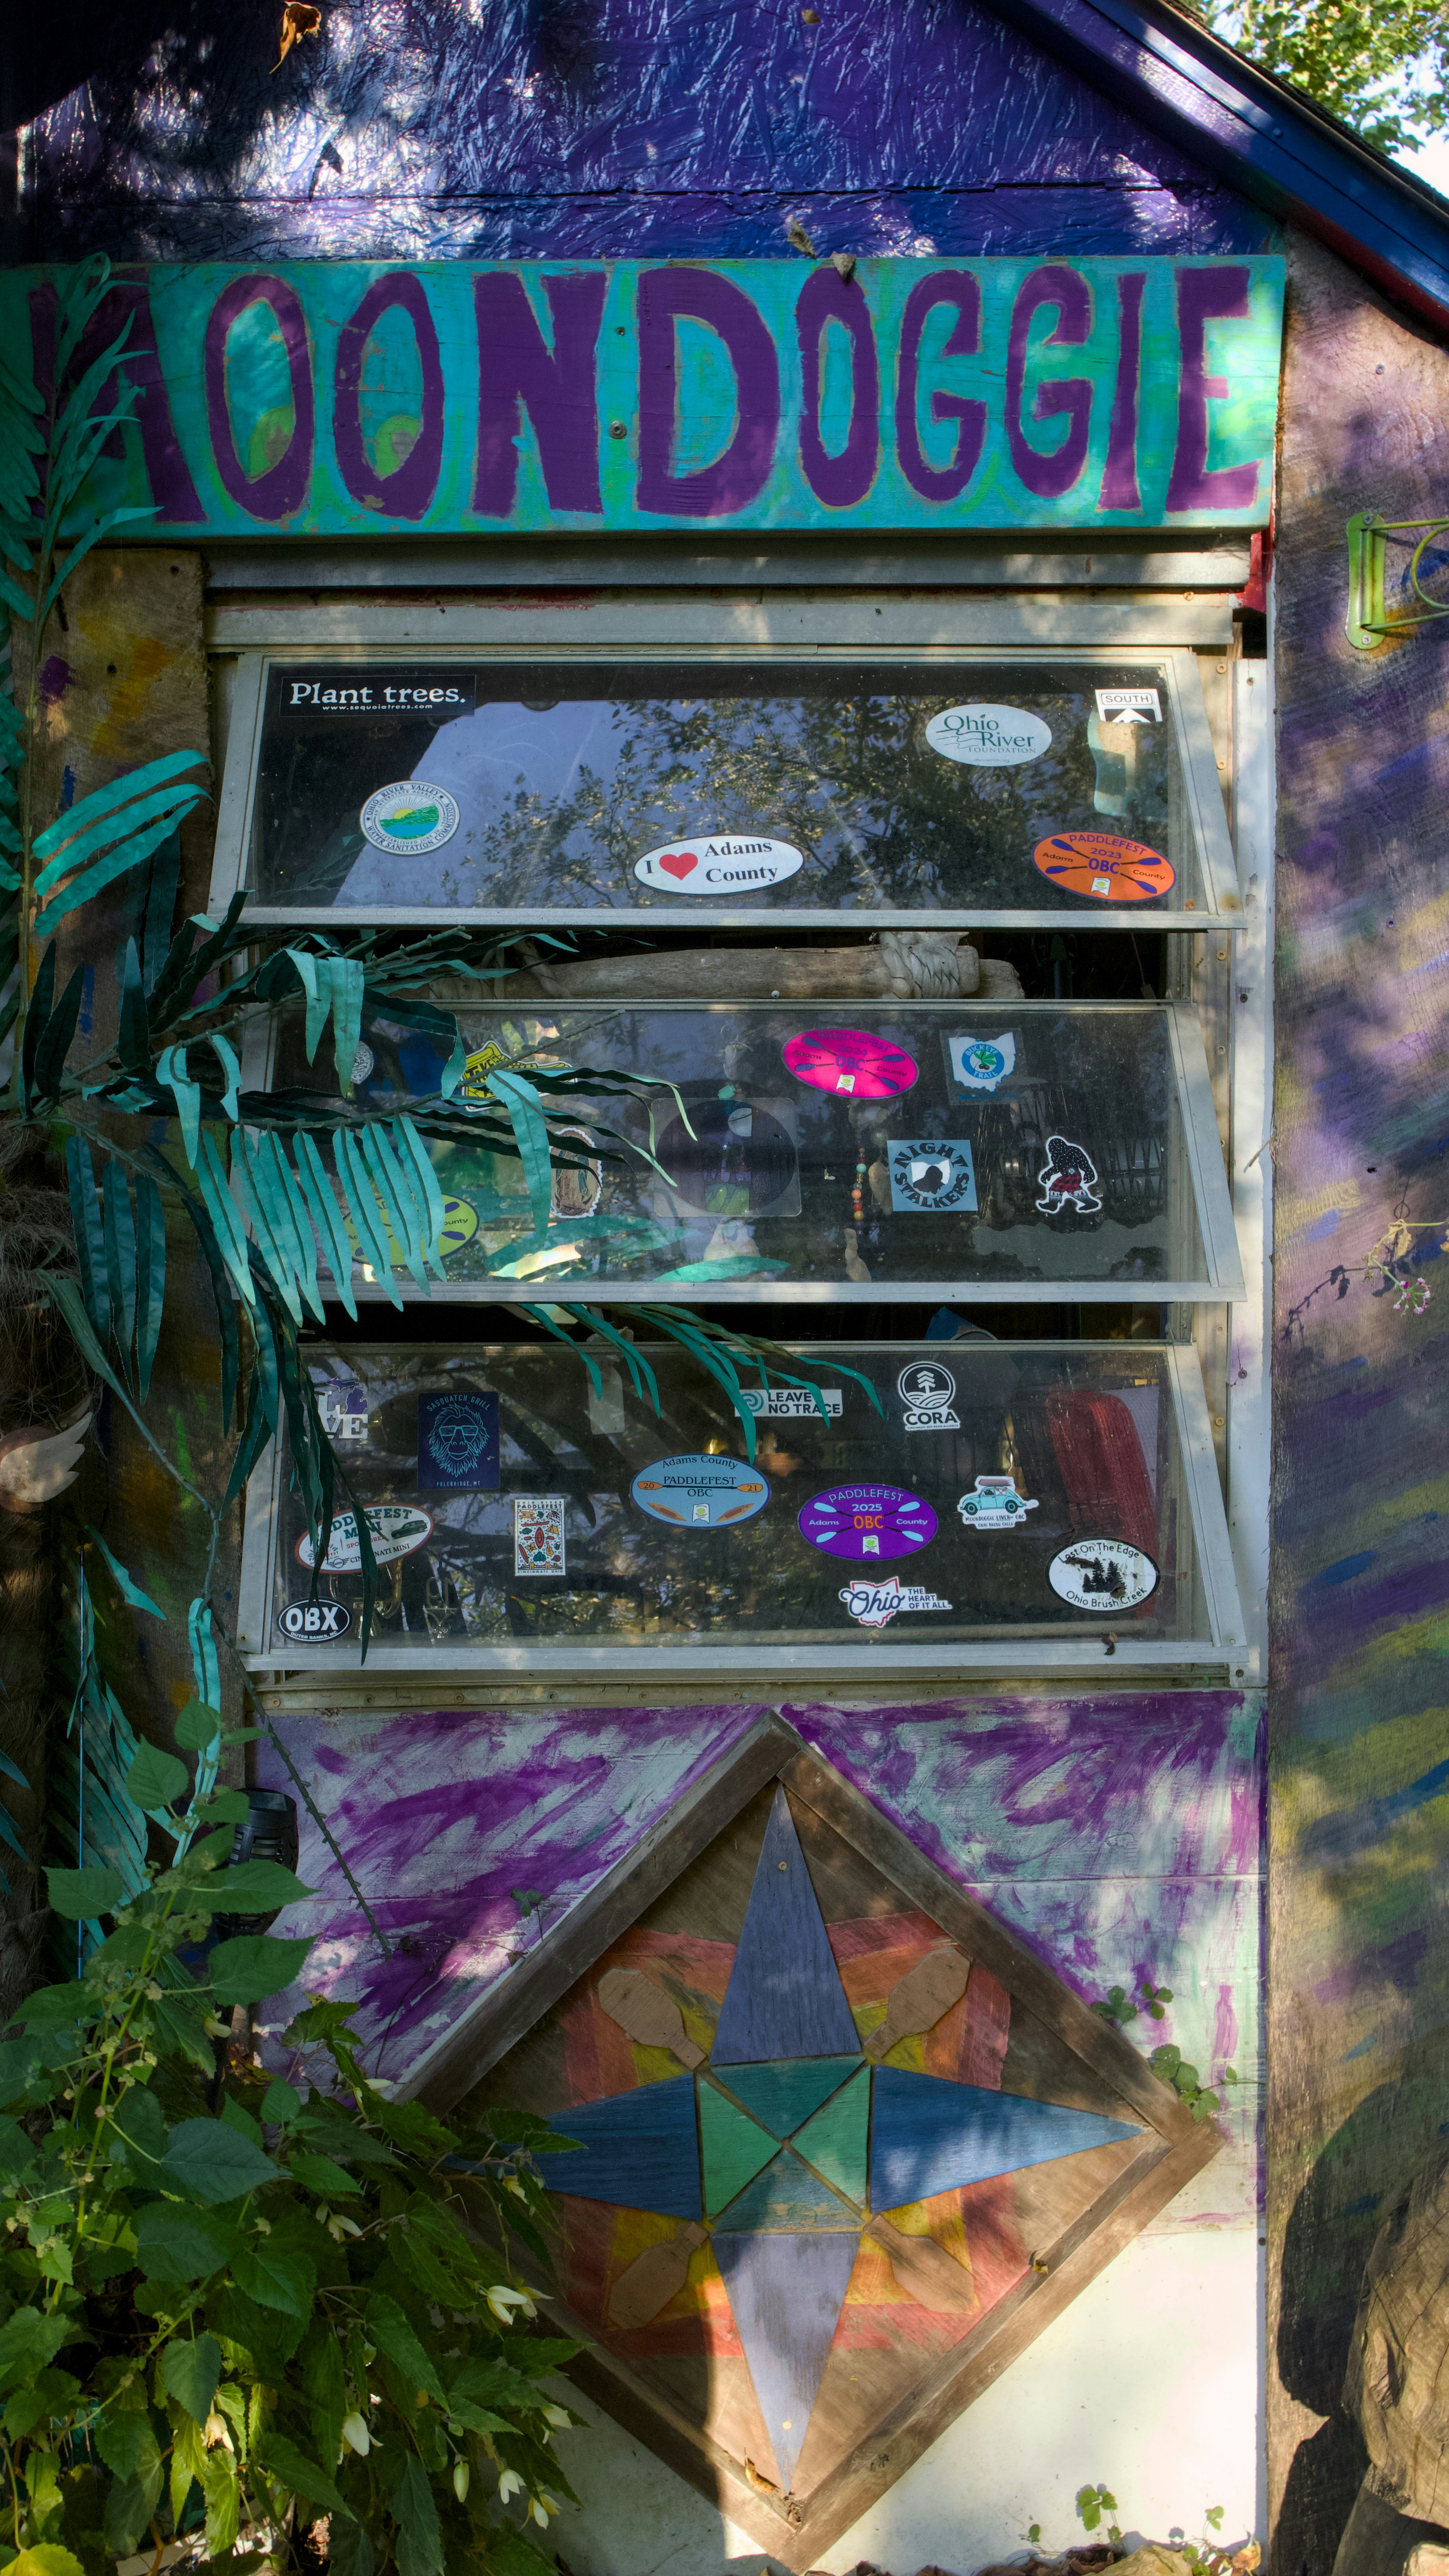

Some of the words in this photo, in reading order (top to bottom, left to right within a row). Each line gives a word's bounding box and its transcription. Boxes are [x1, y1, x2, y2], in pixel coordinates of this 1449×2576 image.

[290, 683, 373, 704] Plant
[383, 686, 466, 703] trees.
[944, 714, 999, 730] Ohio
[981, 732, 1034, 747] River
[367, 799, 379, 816] OHIO
[382, 786, 405, 798] RIVER
[412, 785, 440, 796] VALLEY
[378, 790, 409, 808] INTERSTATE
[413, 790, 435, 799] AGENCY
[367, 826, 386, 845] WATER
[386, 840, 434, 851] SANITATION
[435, 803, 454, 841] COMMISSION
[381, 834, 418, 845] ESTABLISHED
[1069, 834, 1147, 855] PADDLEFEST
[705, 842, 772, 857] Adams
[1042, 852, 1073, 862] Adams
[1090, 847, 1121, 859] 2023
[644, 860, 654, 874] I
[1088, 858, 1120, 874] OBC
[706, 866, 778, 883] County
[1133, 870, 1165, 880] County
[818, 1031, 891, 1052] PADDLEFEST
[792, 1050, 822, 1060] Adams
[838, 1045, 868, 1056] 2024
[965, 1045, 999, 1056] BUCKEYE
[835, 1055, 865, 1071] OBC
[877, 1066, 907, 1077] County
[893, 1143, 969, 1170] NIGHT
[894, 1172, 970, 1208] STALKERS
[444, 1218, 468, 1226] ounty
[426, 1394, 468, 1412] SASQUATCH
[471, 1396, 490, 1411] GRILL
[768, 1392, 812, 1402] LEAVE
[769, 1404, 790, 1414] NO
[906, 1412, 958, 1425] CORA
[663, 1457, 697, 1468] Adams
[701, 1456, 738, 1470] County
[664, 1476, 737, 1485] PADDLEFEST
[828, 1489, 903, 1503] PADDLEFEST
[854, 1515, 884, 1529] OBC
[393, 1543, 410, 1553] MINI
[1058, 1548, 1080, 1563] Lost
[1080, 1545, 1095, 1553] On
[1097, 1543, 1114, 1551] The
[1117, 1544, 1139, 1559] Edge
[840, 1590, 905, 1616] Ohio
[1066, 1591, 1088, 1605] Ohio
[1092, 1598, 1119, 1608] Brush
[1120, 1586, 1147, 1604] Creek
[286, 1607, 339, 1632] OBX
